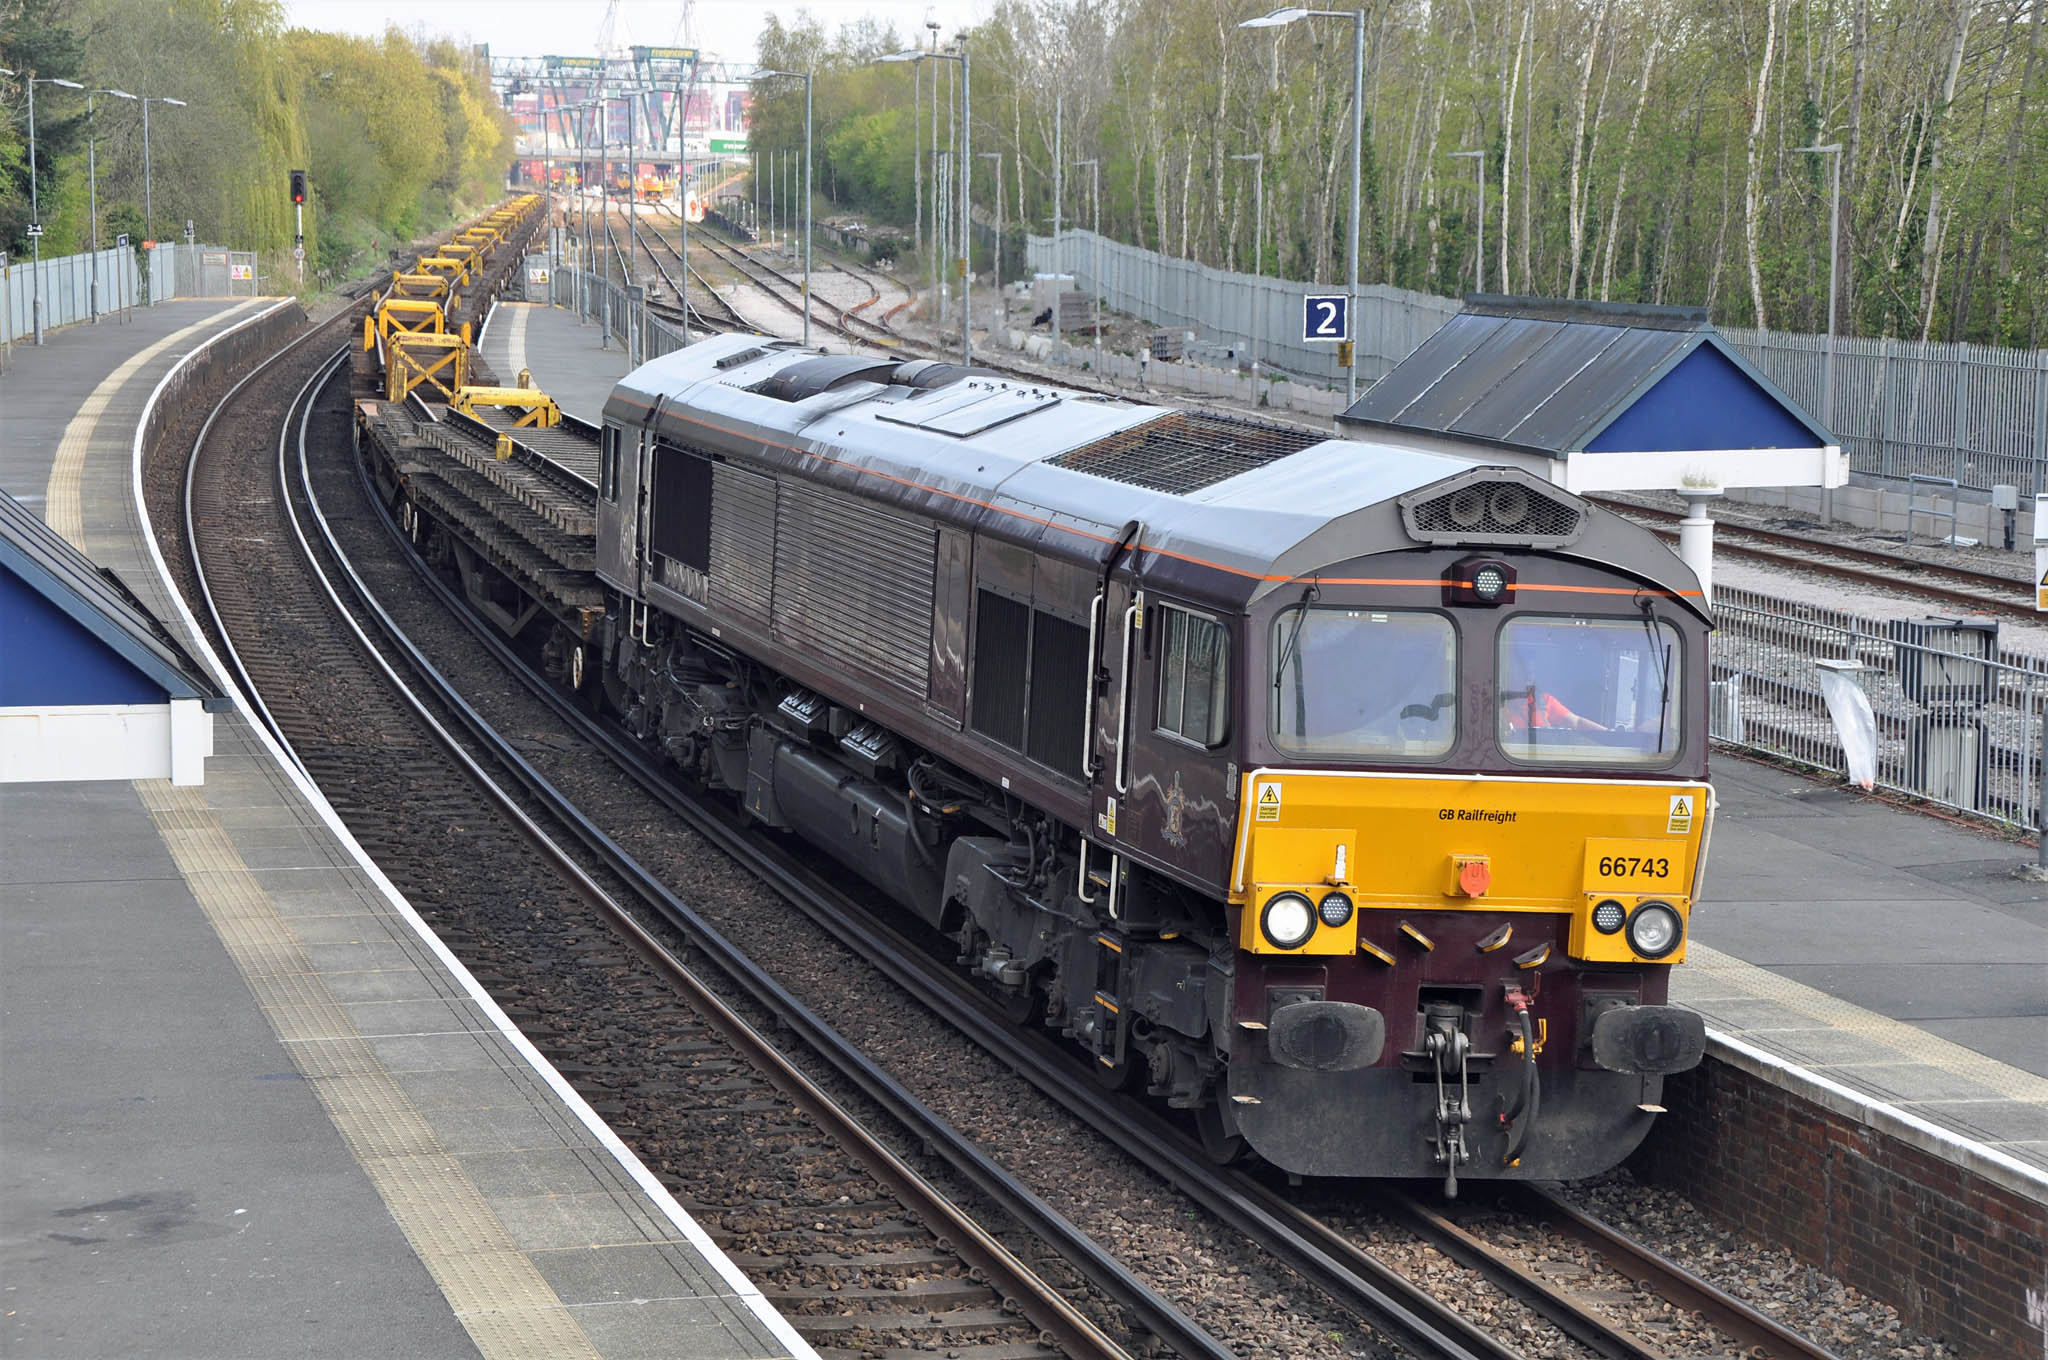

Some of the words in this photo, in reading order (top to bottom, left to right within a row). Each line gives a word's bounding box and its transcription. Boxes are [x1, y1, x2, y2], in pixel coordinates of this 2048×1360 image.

[1316, 301, 1337, 334] 2
[1439, 809, 1454, 820] GB
[1457, 809, 1517, 824] Railfreight
[1599, 856, 1669, 878] 66743
